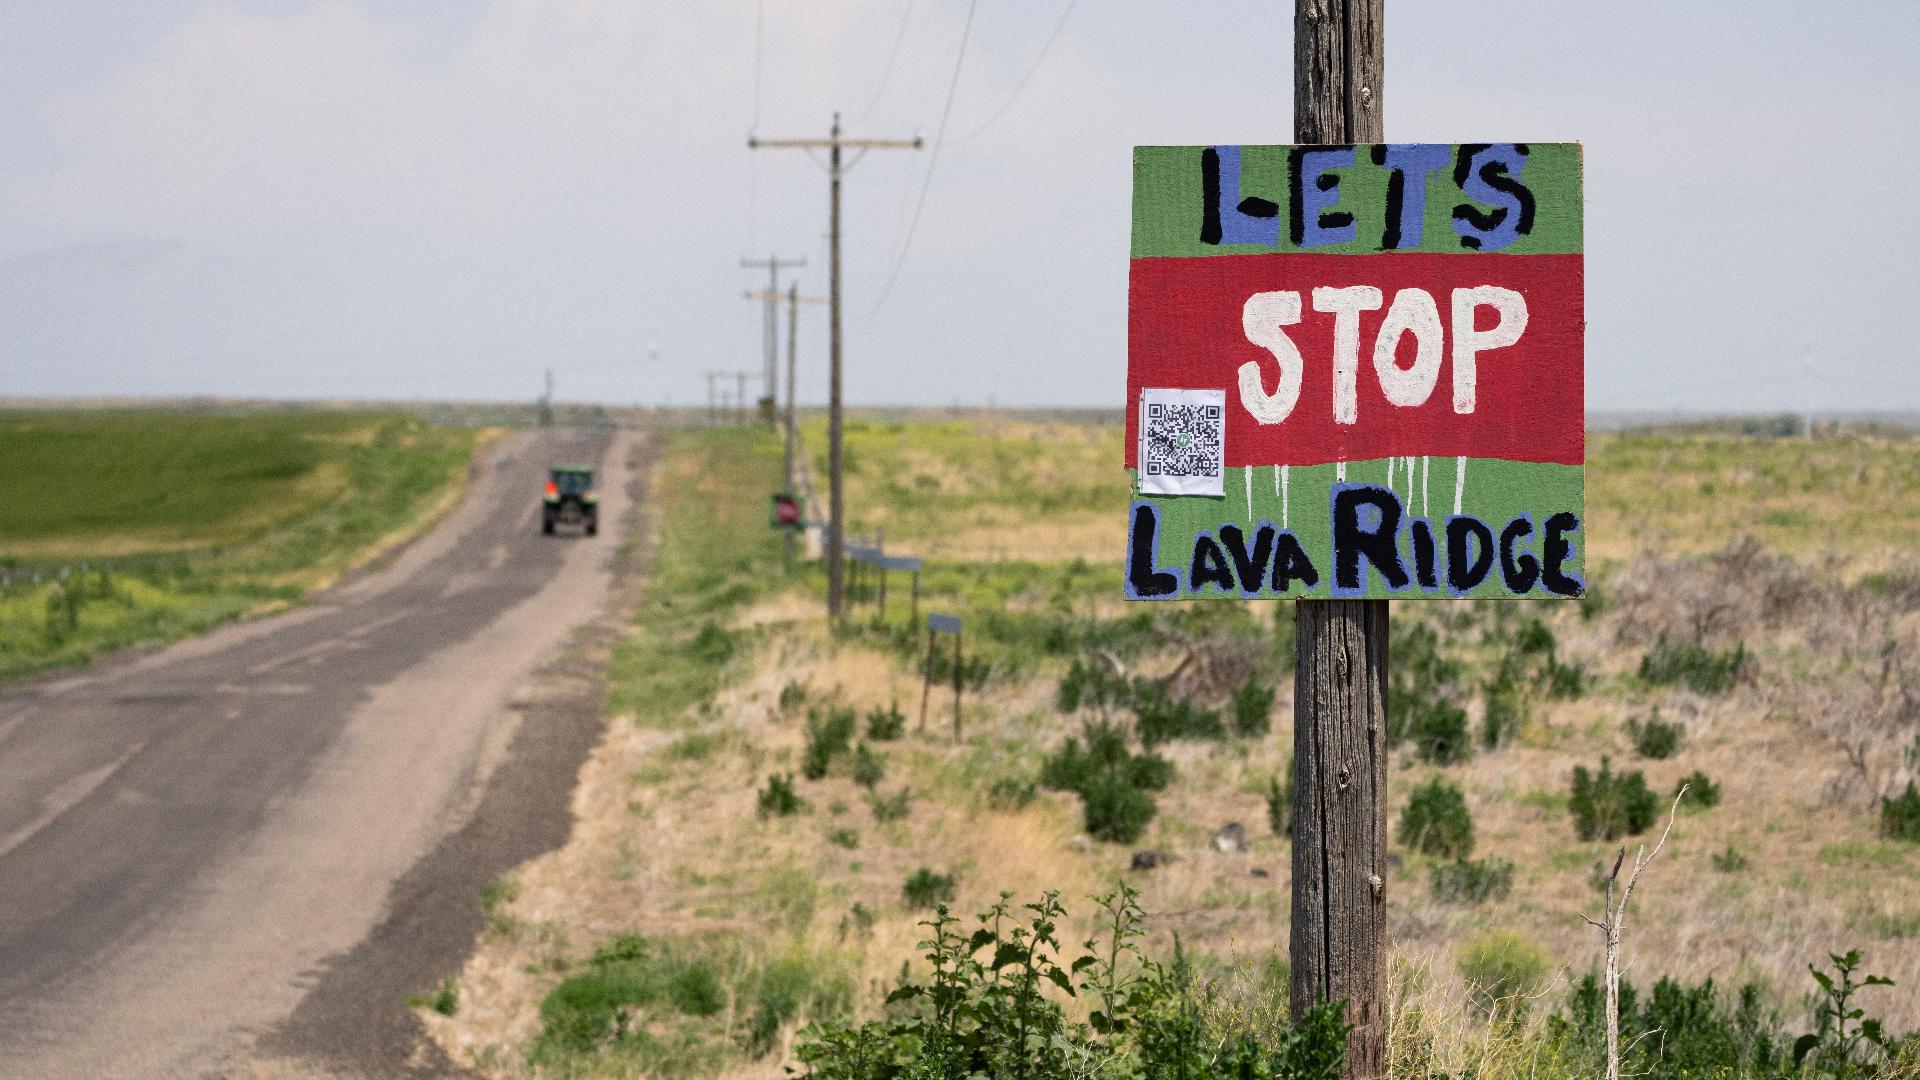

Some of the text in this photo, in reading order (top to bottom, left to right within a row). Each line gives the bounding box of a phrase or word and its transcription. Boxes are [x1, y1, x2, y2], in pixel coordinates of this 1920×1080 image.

[1200, 144, 1536, 251] LETS
[1239, 286, 1529, 425] STOP
[1125, 483, 1585, 598] LAVA RIDGE
